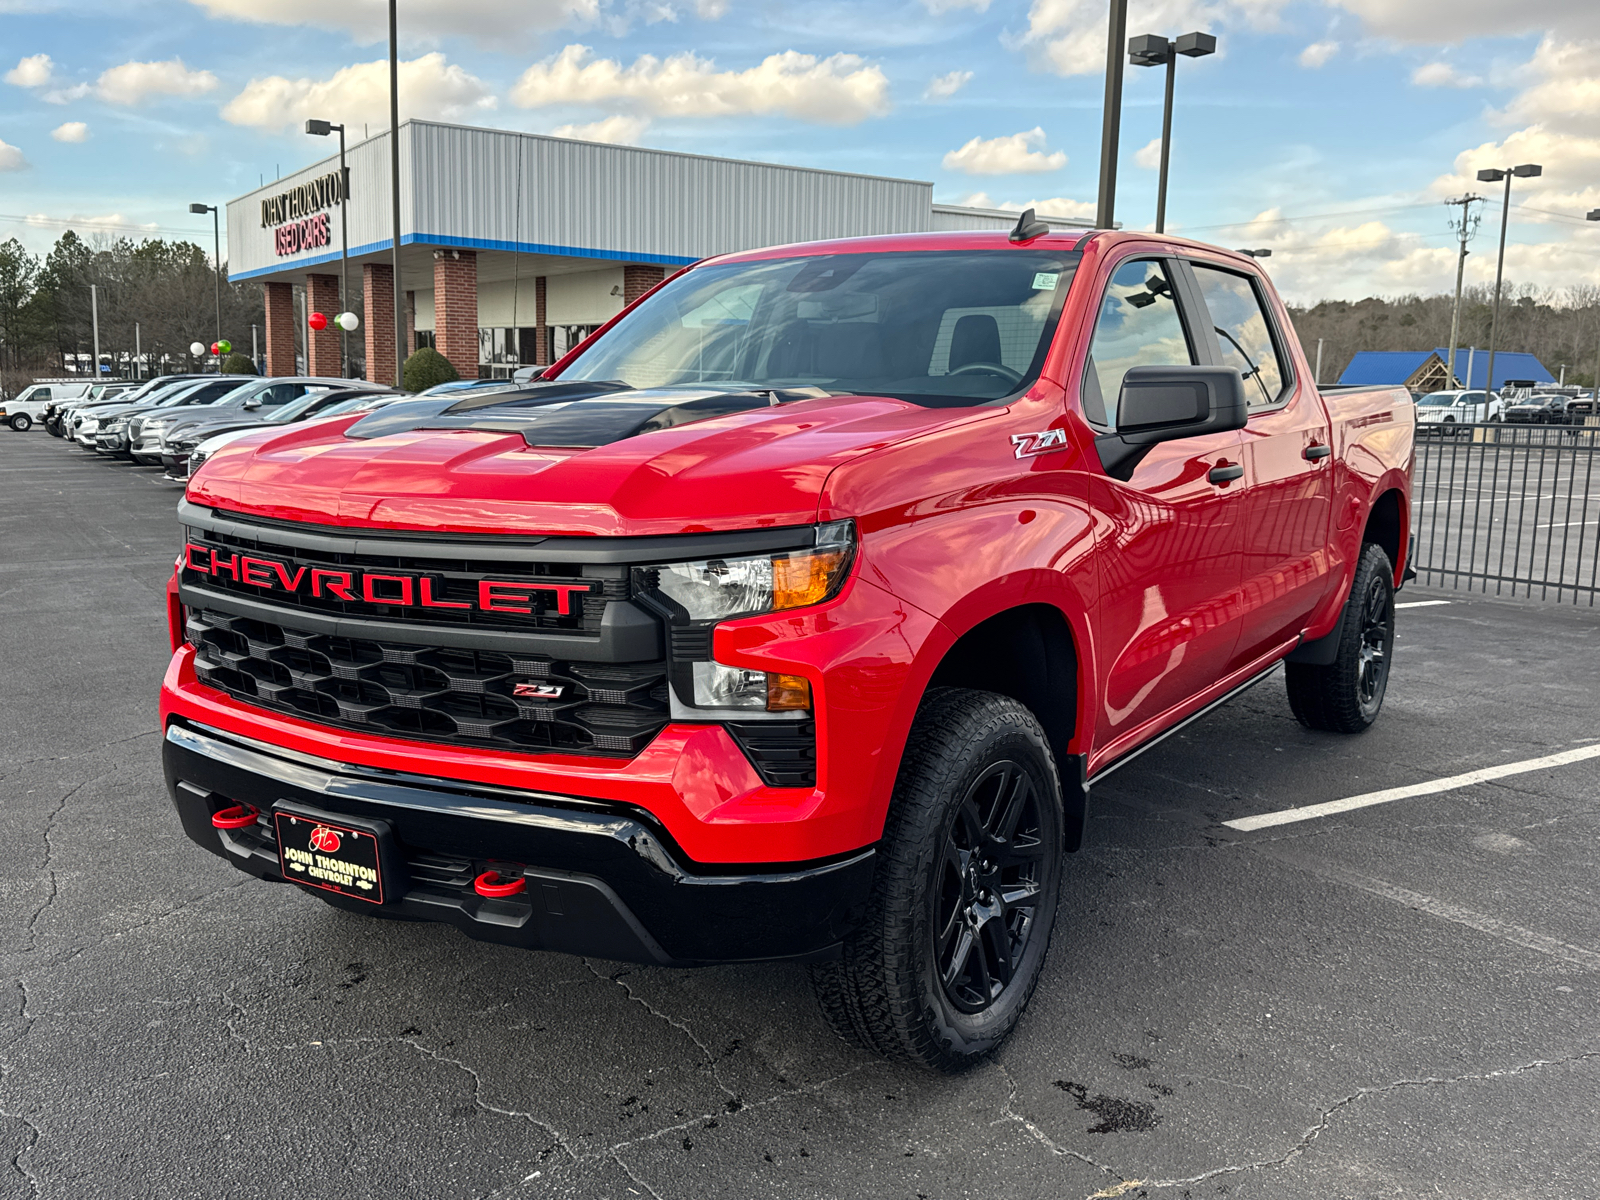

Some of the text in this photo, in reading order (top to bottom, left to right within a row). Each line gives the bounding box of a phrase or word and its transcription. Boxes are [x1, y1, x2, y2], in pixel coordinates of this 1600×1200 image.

[261, 194, 285, 228] JOHN
[274, 213, 331, 256] USED CARS
[1009, 428, 1068, 460] Z71
[186, 542, 592, 616] CHEVROLET
[513, 683, 565, 698] Z71
[285, 847, 377, 882] JOHN THORNTON
[308, 866, 353, 887] CHEVROLET
